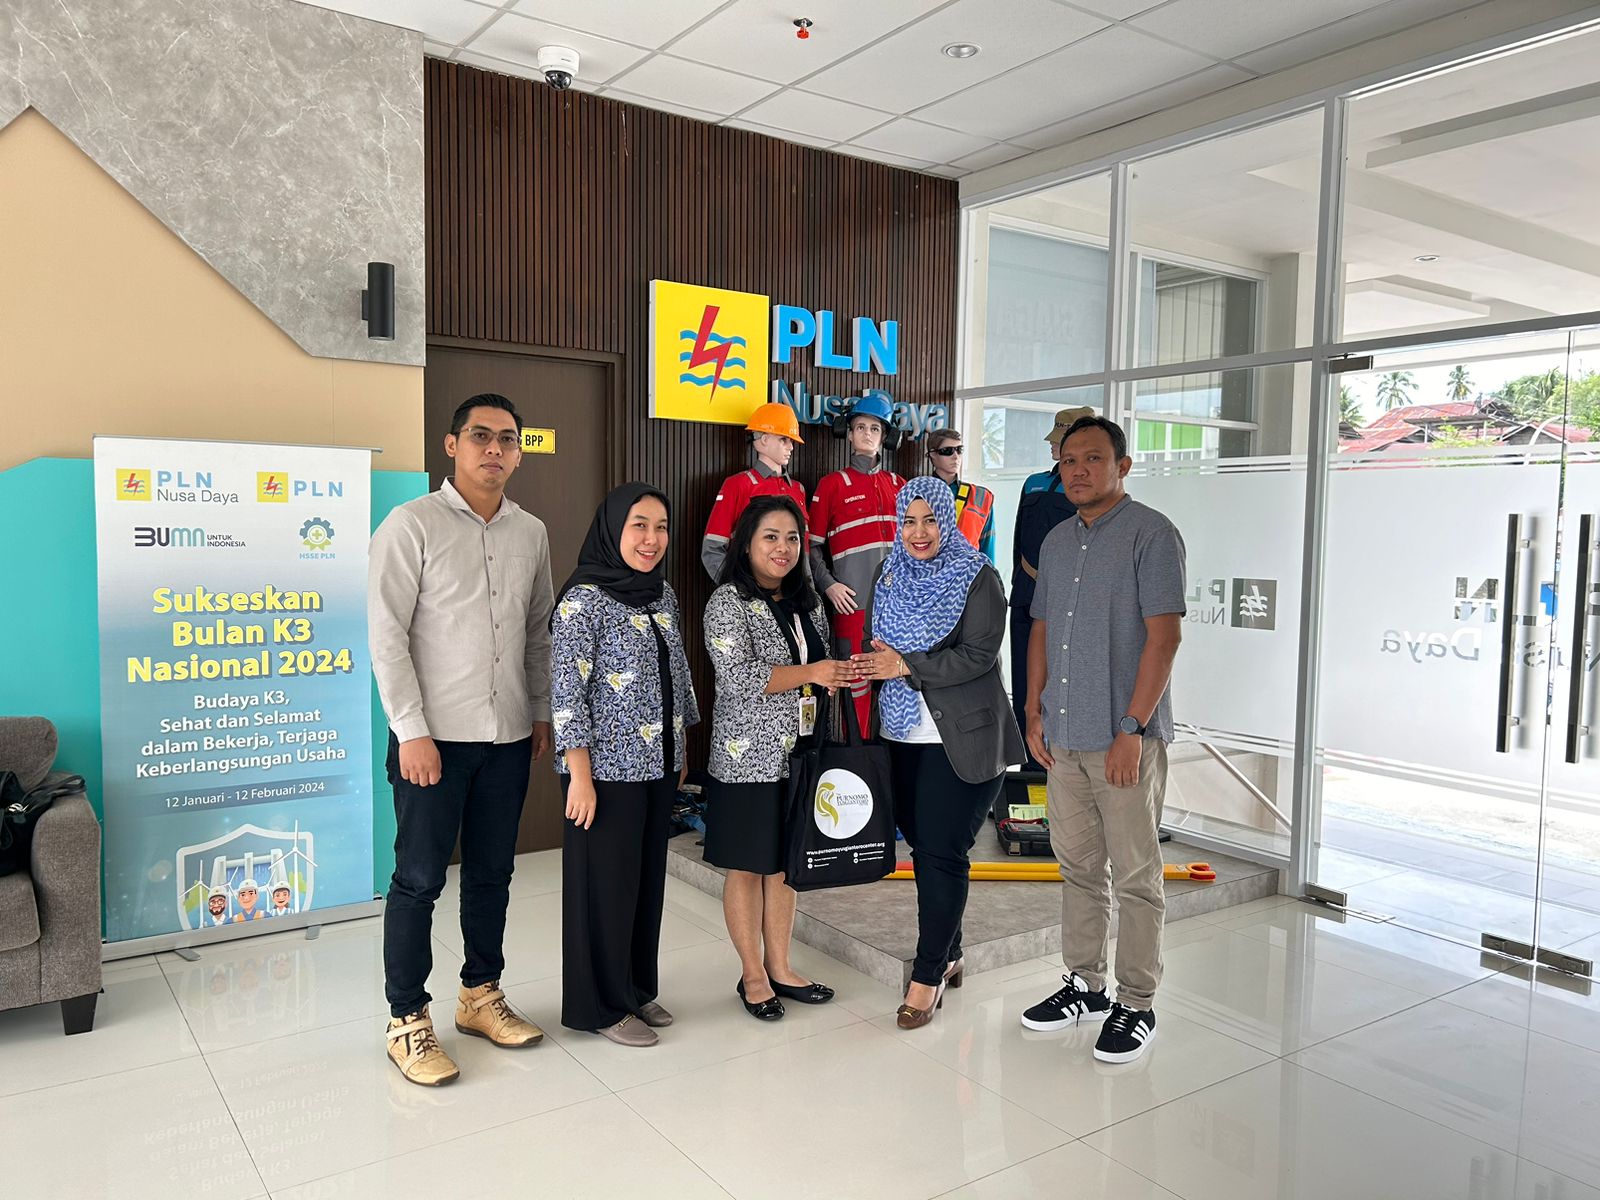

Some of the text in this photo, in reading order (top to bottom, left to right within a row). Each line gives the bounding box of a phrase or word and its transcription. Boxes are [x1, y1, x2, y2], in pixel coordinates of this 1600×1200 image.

[772, 304, 898, 375] PLN
[525, 434, 544, 447] BPP
[157, 470, 212, 488] PLN
[294, 480, 343, 497] PLN
[157, 489, 239, 506] Nusa Daya
[299, 552, 320, 560] HSSE
[152, 585, 321, 613] Sukseskan
[172, 618, 312, 647] Bulan K3
[127, 648, 352, 682] Nasional 2024
[193, 690, 290, 710] Budaya K3,
[160, 708, 321, 733] Sehat dan Selamat
[141, 728, 338, 756] dalam Bekerja, Terjaga
[136, 746, 346, 778] Keberlangsungan Usaha
[165, 798, 180, 808] 12
[182, 792, 225, 808] Januari
[235, 790, 248, 801] 12
[252, 784, 296, 799] Februari
[298, 781, 325, 794] 2024
